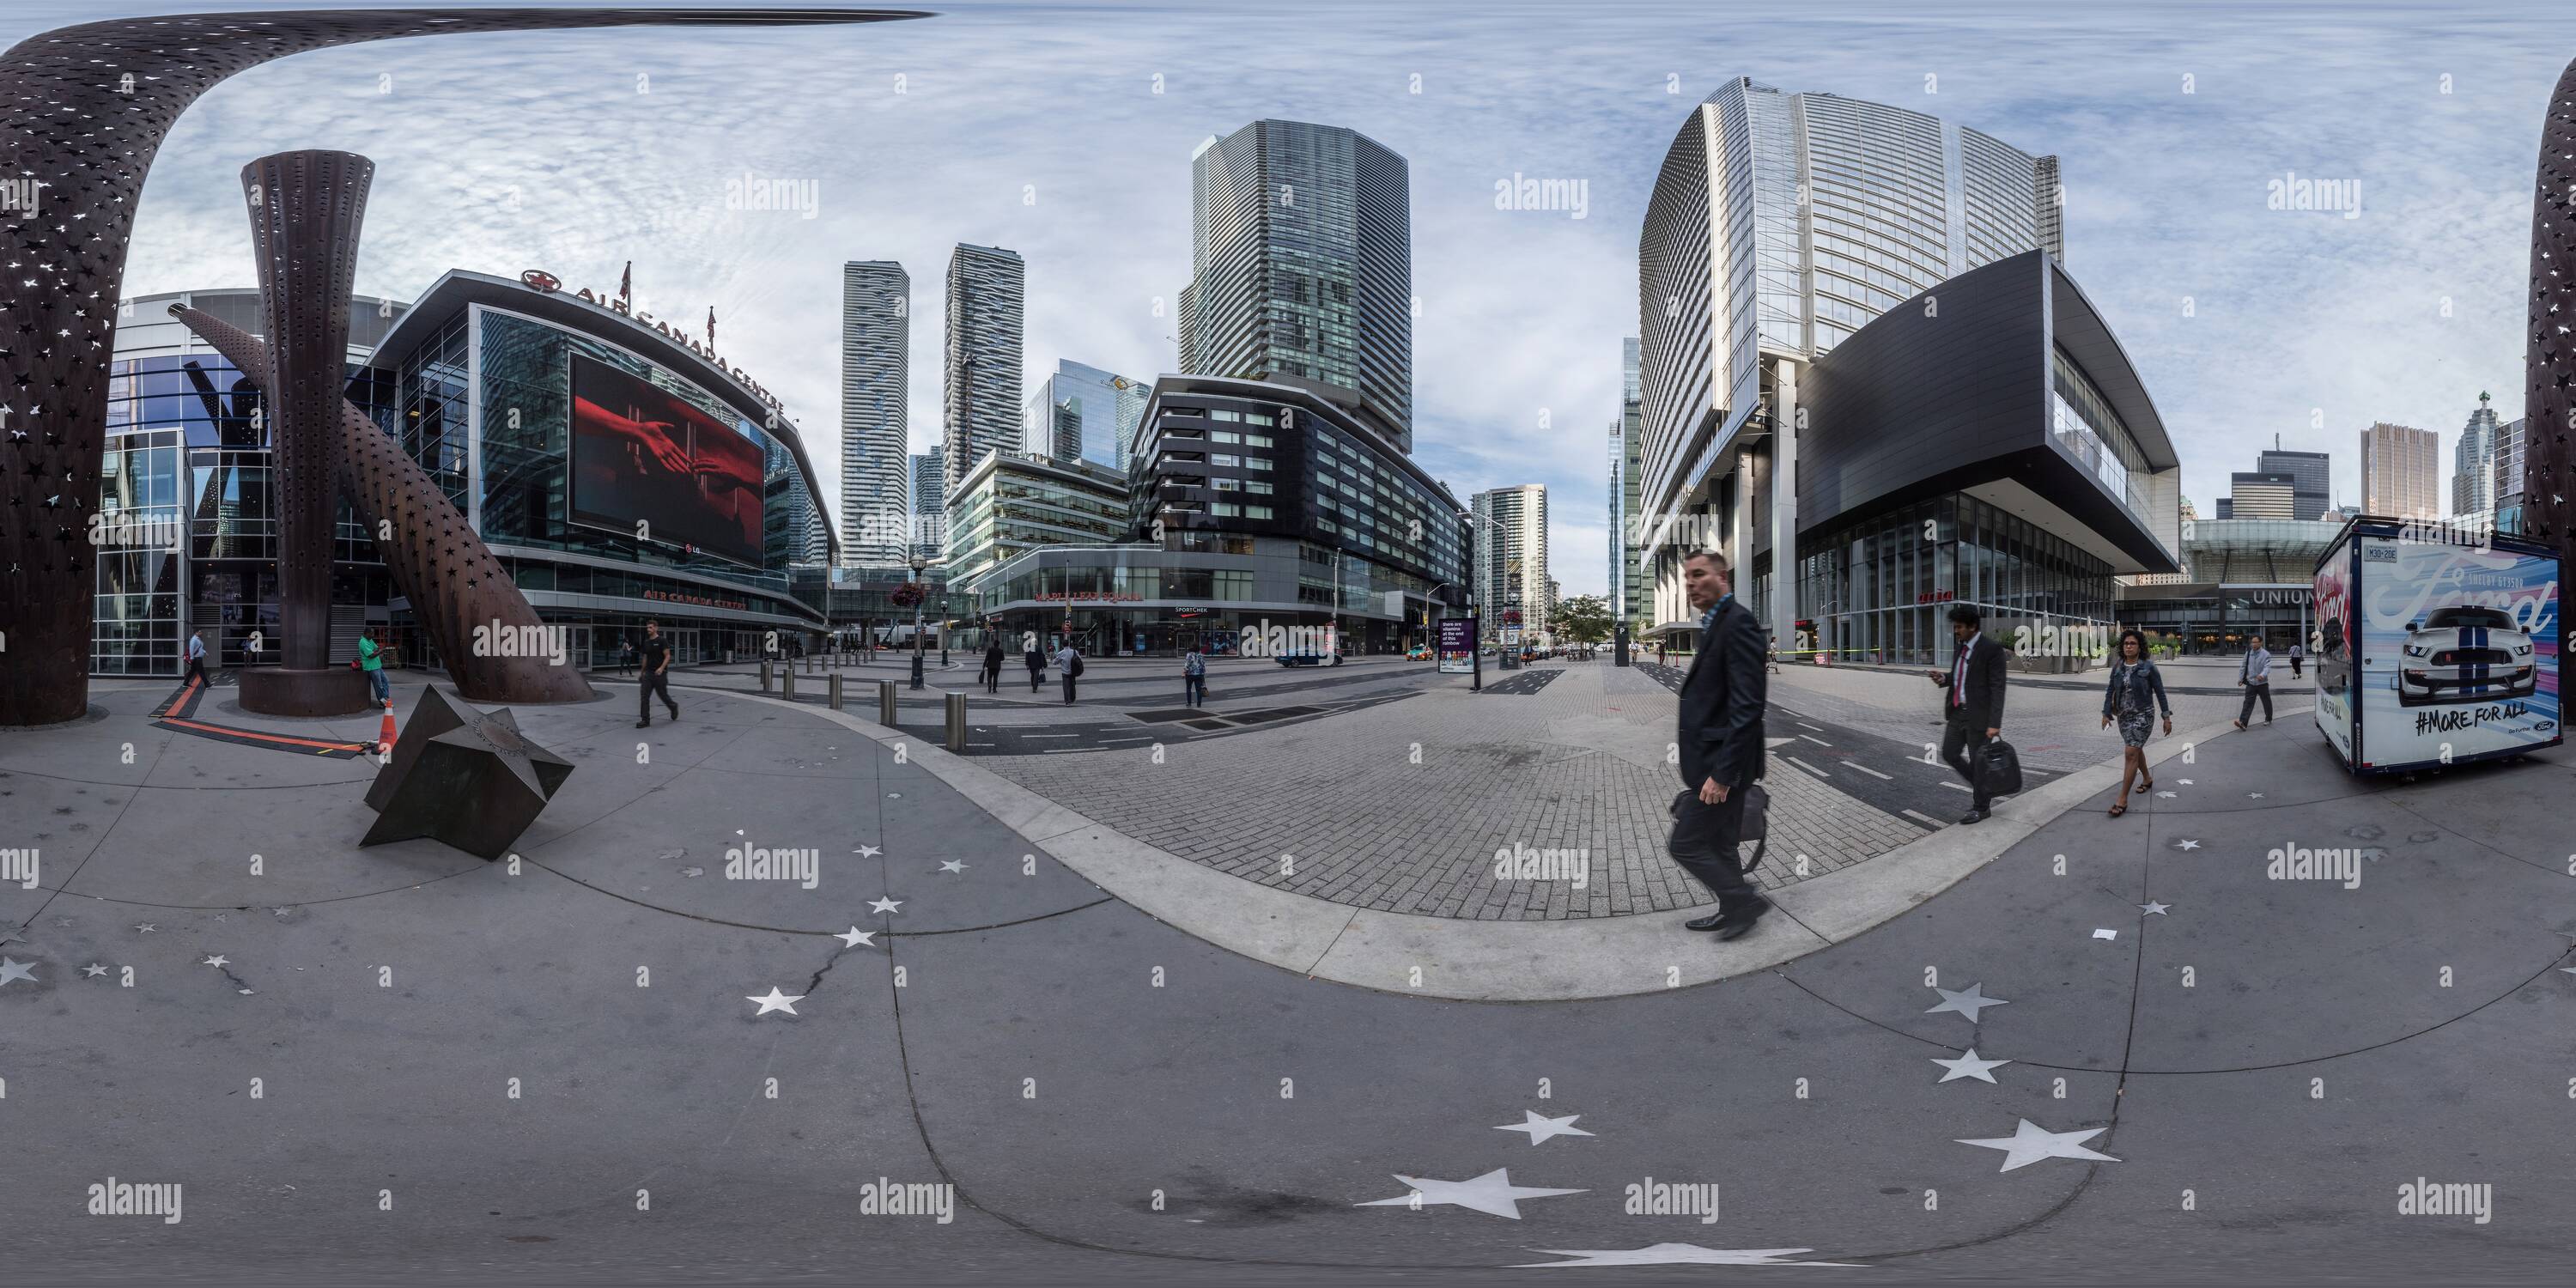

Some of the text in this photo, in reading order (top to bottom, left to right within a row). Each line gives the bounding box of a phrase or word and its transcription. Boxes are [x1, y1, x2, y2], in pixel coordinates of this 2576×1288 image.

[576, 288, 784, 416] AIR CANADA CENTRE
[645, 590, 666, 600] AIR
[2415, 702, 2529, 736] #MORE FOR ALL
